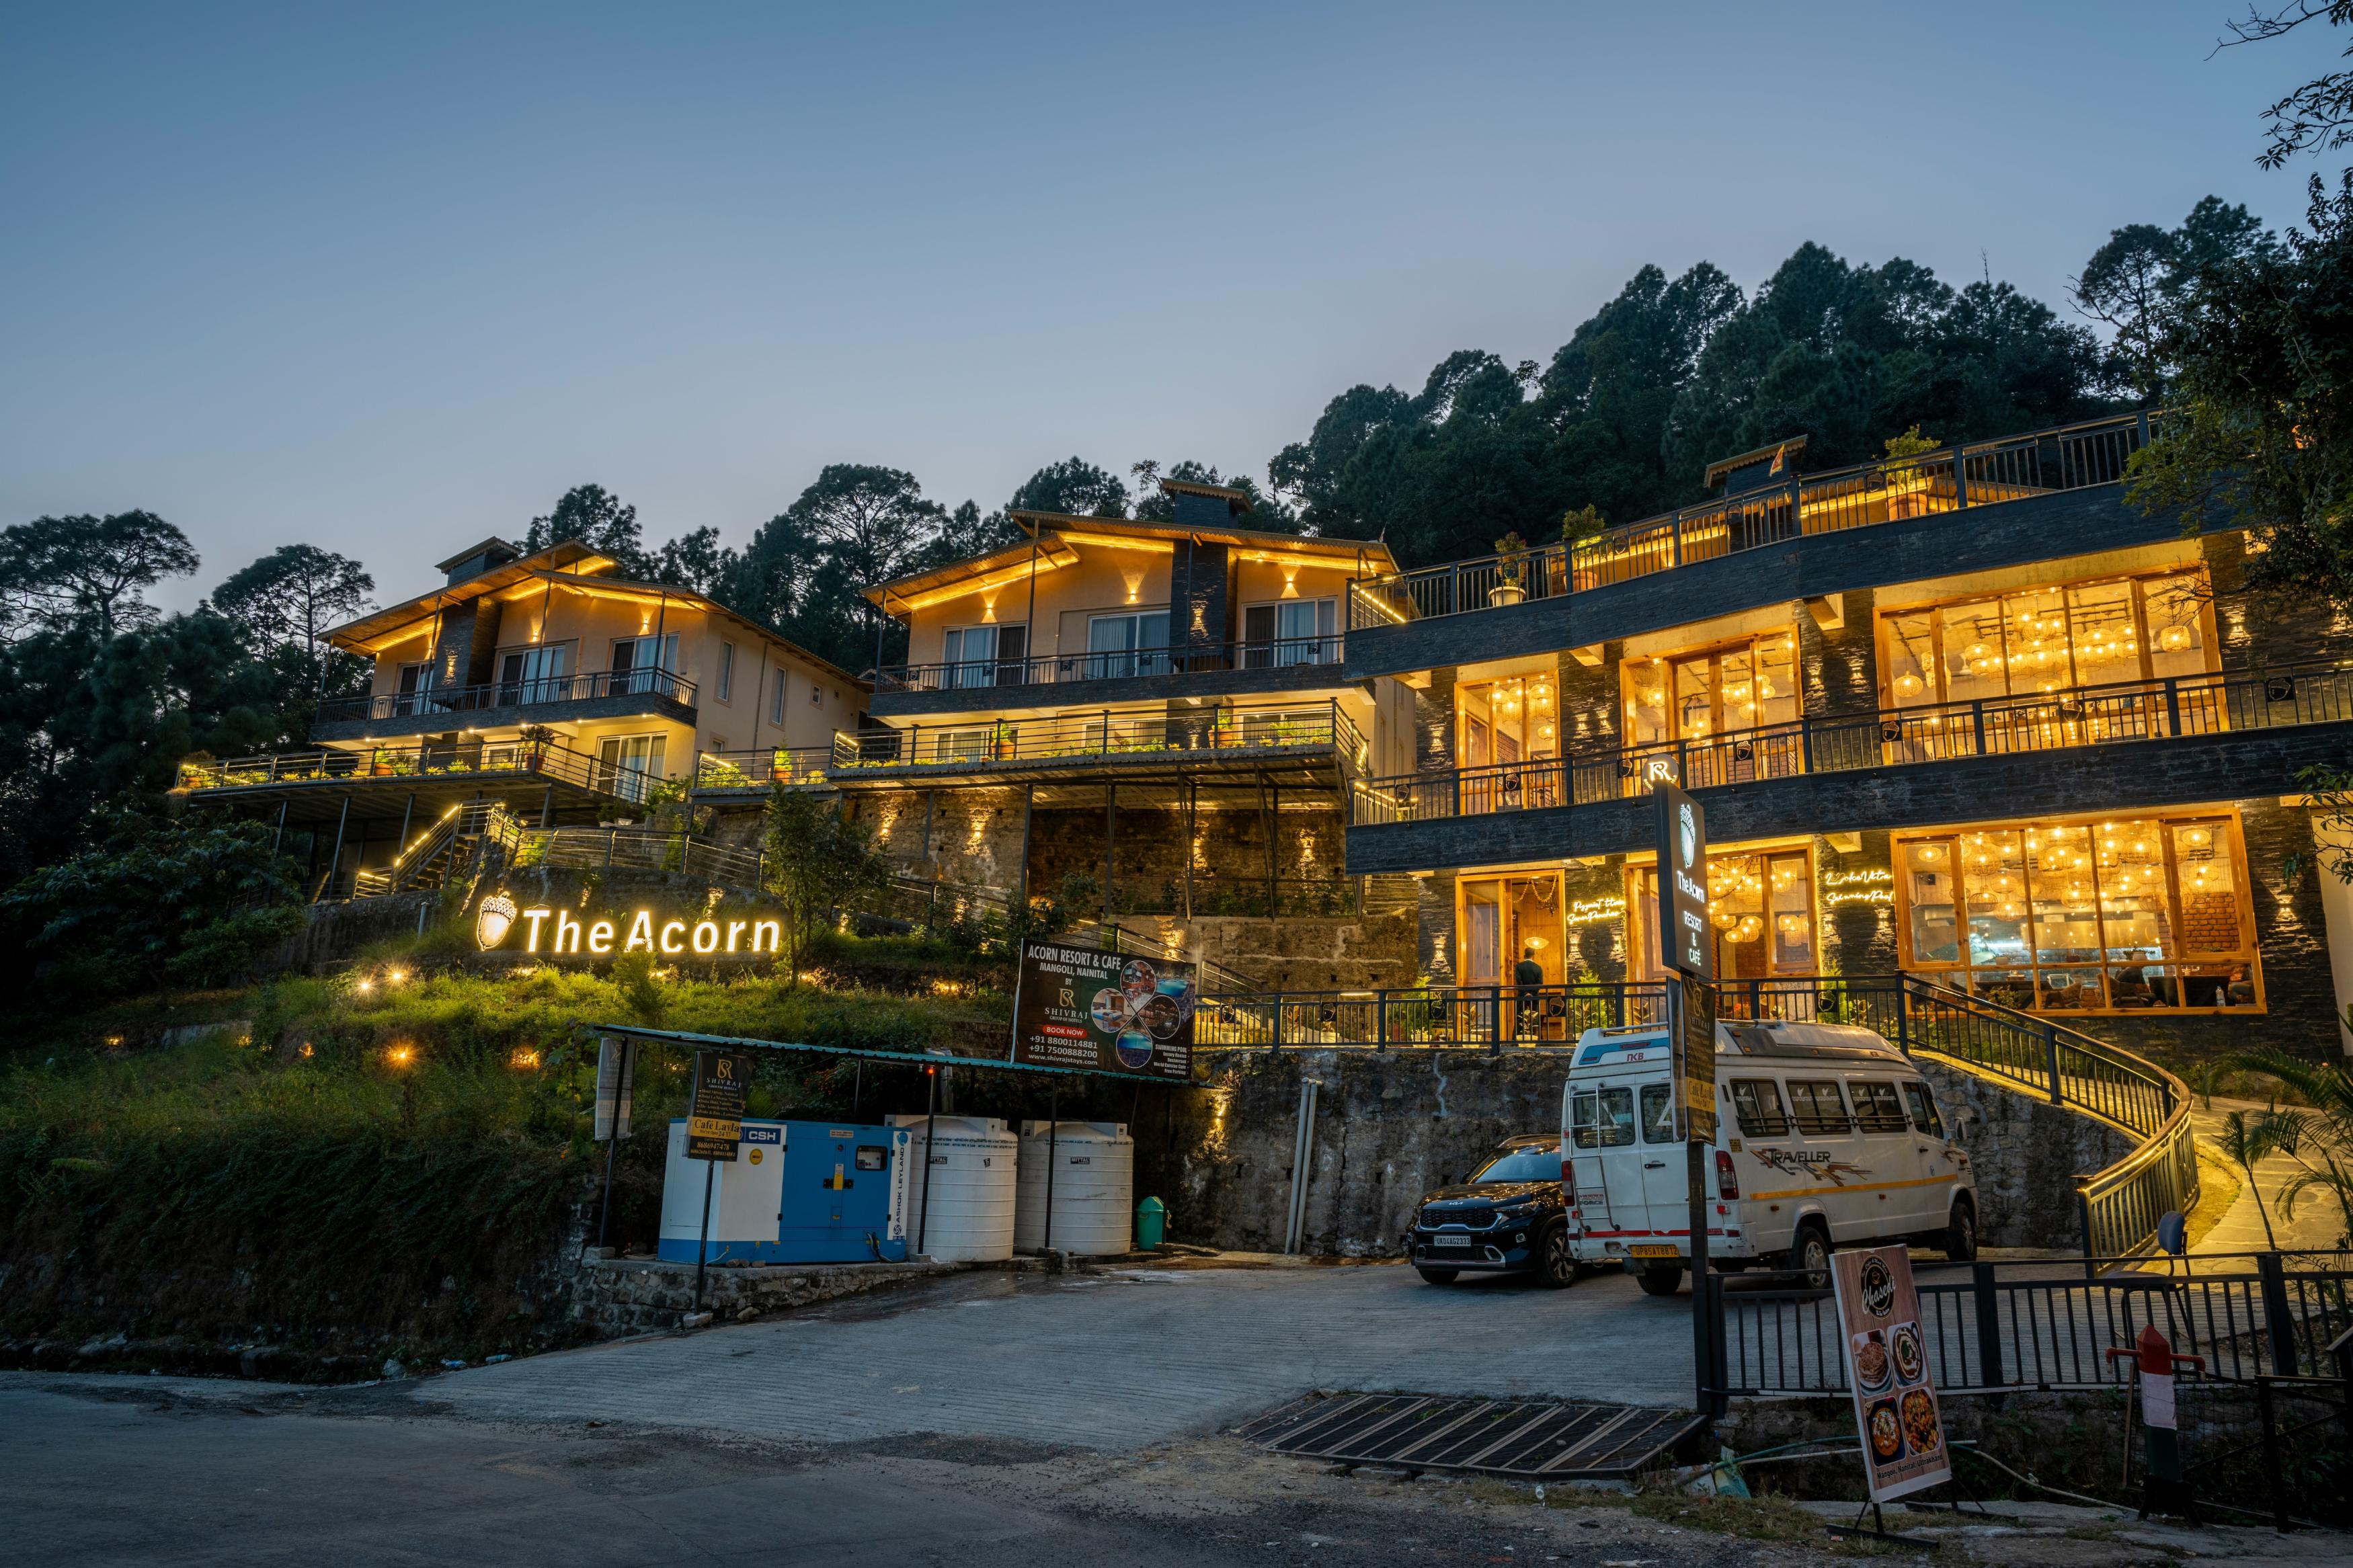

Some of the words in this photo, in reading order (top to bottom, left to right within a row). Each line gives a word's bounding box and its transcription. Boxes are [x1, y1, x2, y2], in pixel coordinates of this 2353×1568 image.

[1683, 911, 1702, 933] RESORT
[523, 910, 613, 953] The
[624, 911, 780, 953] Acorn
[1692, 932, 1697, 946] &
[1028, 945, 1058, 961] ACORN
[1060, 949, 1091, 966] RESORT
[1093, 954, 1099, 967] &
[1102, 955, 1121, 971] CAFE
[1689, 948, 1702, 966] CAFÉ
[1039, 962, 1076, 977] MANGOLI,
[1076, 967, 1109, 979] NAINITAL
[1045, 1007, 1088, 1020] SHIVRAJ
[1046, 1026, 1066, 1034] BOOK
[1030, 1035, 1045, 1043] +91
[1047, 1037, 1098, 1049] 8800114881
[1029, 1044, 1045, 1053] +91
[1047, 1046, 1098, 1058] 7500888200
[1028, 1053, 1098, 1065] www.shivrajstays.com
[706, 1077, 741, 1087] SHIVRAJ
[694, 1118, 713, 1130] Café
[748, 1130, 776, 1141] CSH
[1767, 1148, 1831, 1163] TRAVELLER
[1436, 1236, 1470, 1245] UK04AG2333
[1636, 1247, 1678, 1255] UP85AT8812
